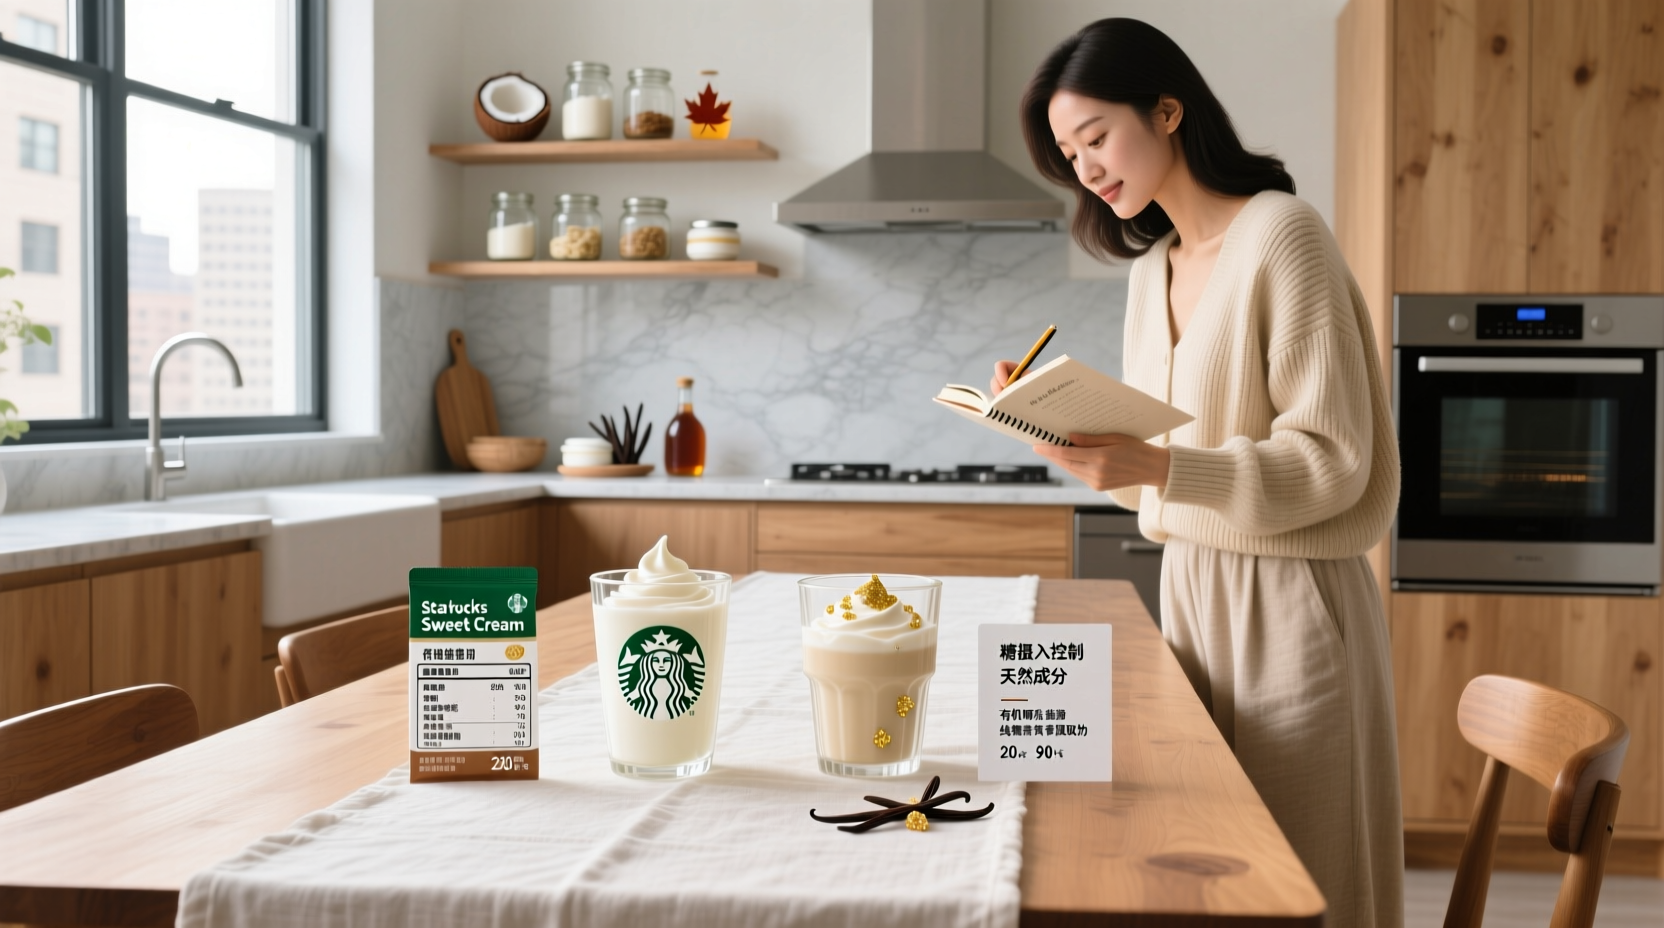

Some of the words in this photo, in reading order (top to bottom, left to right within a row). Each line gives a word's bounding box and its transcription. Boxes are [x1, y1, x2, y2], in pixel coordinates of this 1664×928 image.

[421, 617, 471, 632] Sweet
[474, 617, 525, 632] Cream
[1000, 667, 1068, 686] 天然成分
